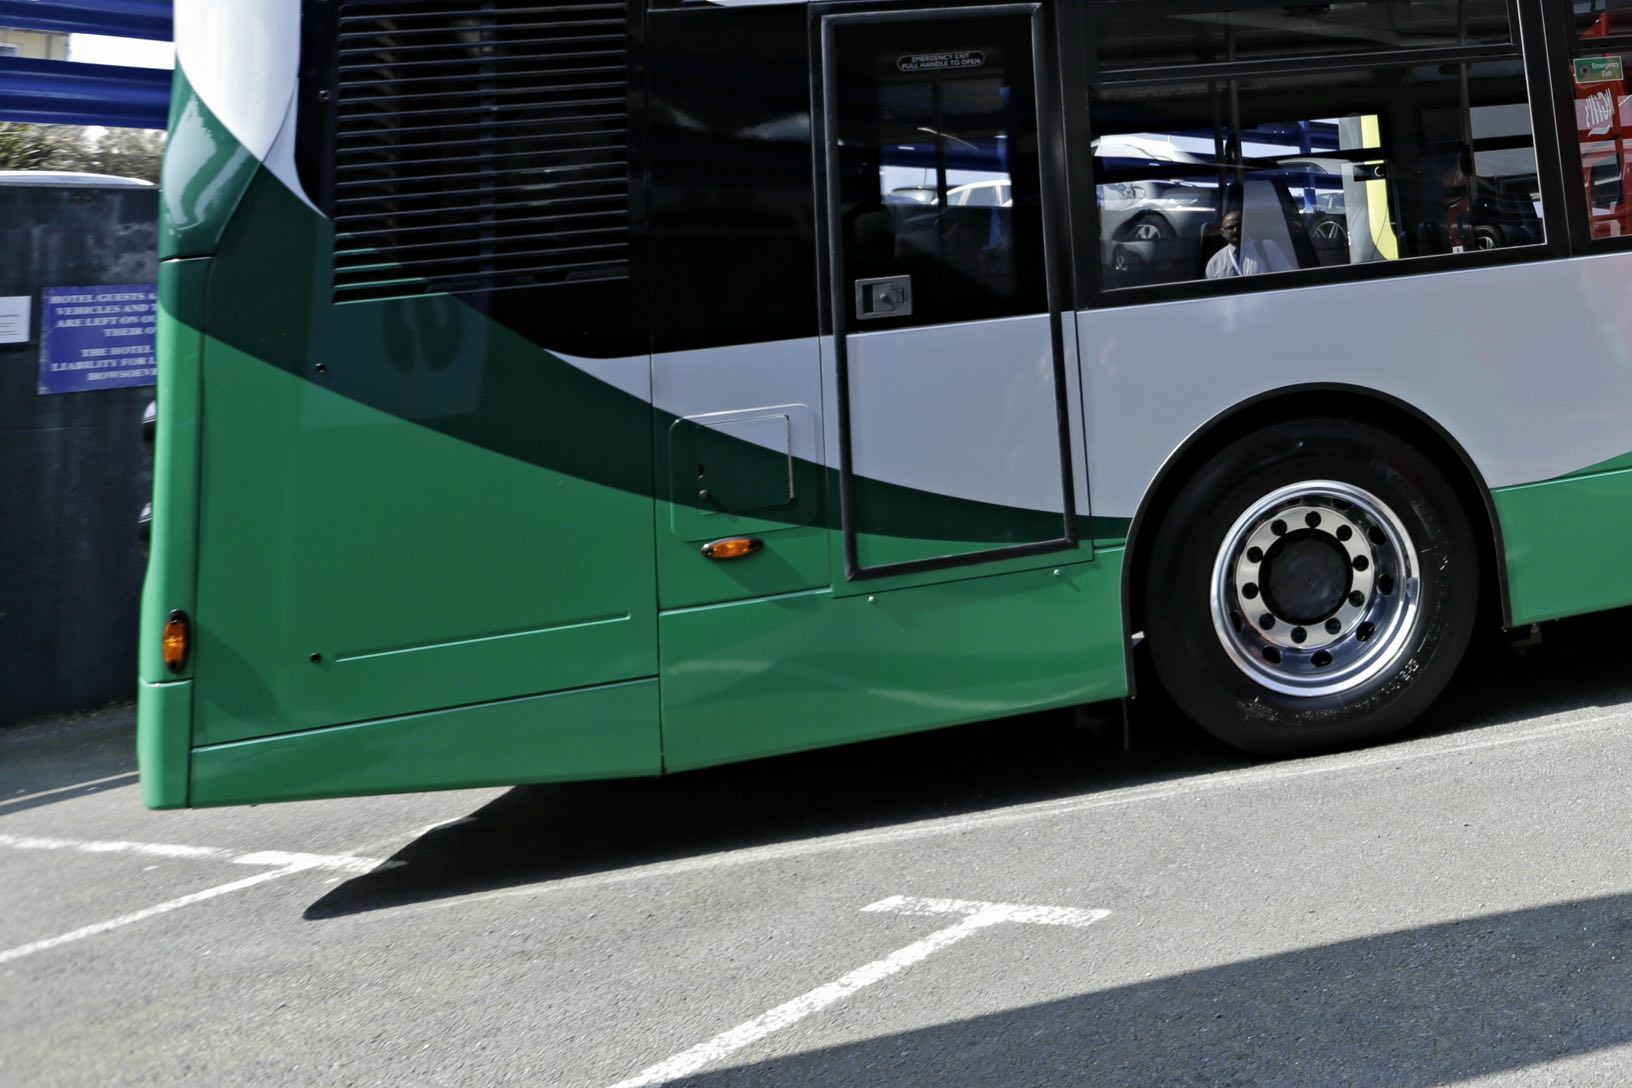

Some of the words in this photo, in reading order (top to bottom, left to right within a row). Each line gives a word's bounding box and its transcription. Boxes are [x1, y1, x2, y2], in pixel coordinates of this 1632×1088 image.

[901, 61, 919, 70] PULL
[920, 59, 949, 69] HANDLE
[950, 58, 960, 66] TO
[961, 57, 980, 66] OPEN
[911, 53, 953, 63] EMERGENCY
[954, 52, 970, 60] EXIT
[50, 294, 94, 305] HOTEL
[96, 292, 146, 303] GUESTS
[55, 305, 121, 316] VEHICLES
[122, 303, 150, 313] AND
[55, 318, 83, 328] ARE
[85, 316, 119, 327] LEFT
[119, 315, 140, 325] ON
[104, 327, 144, 337] THEIR
[80, 347, 109, 358] THE
[110, 345, 154, 356] HOTEL
[50, 359, 118, 372] LIABILITY
[121, 356, 147, 366] FOR
